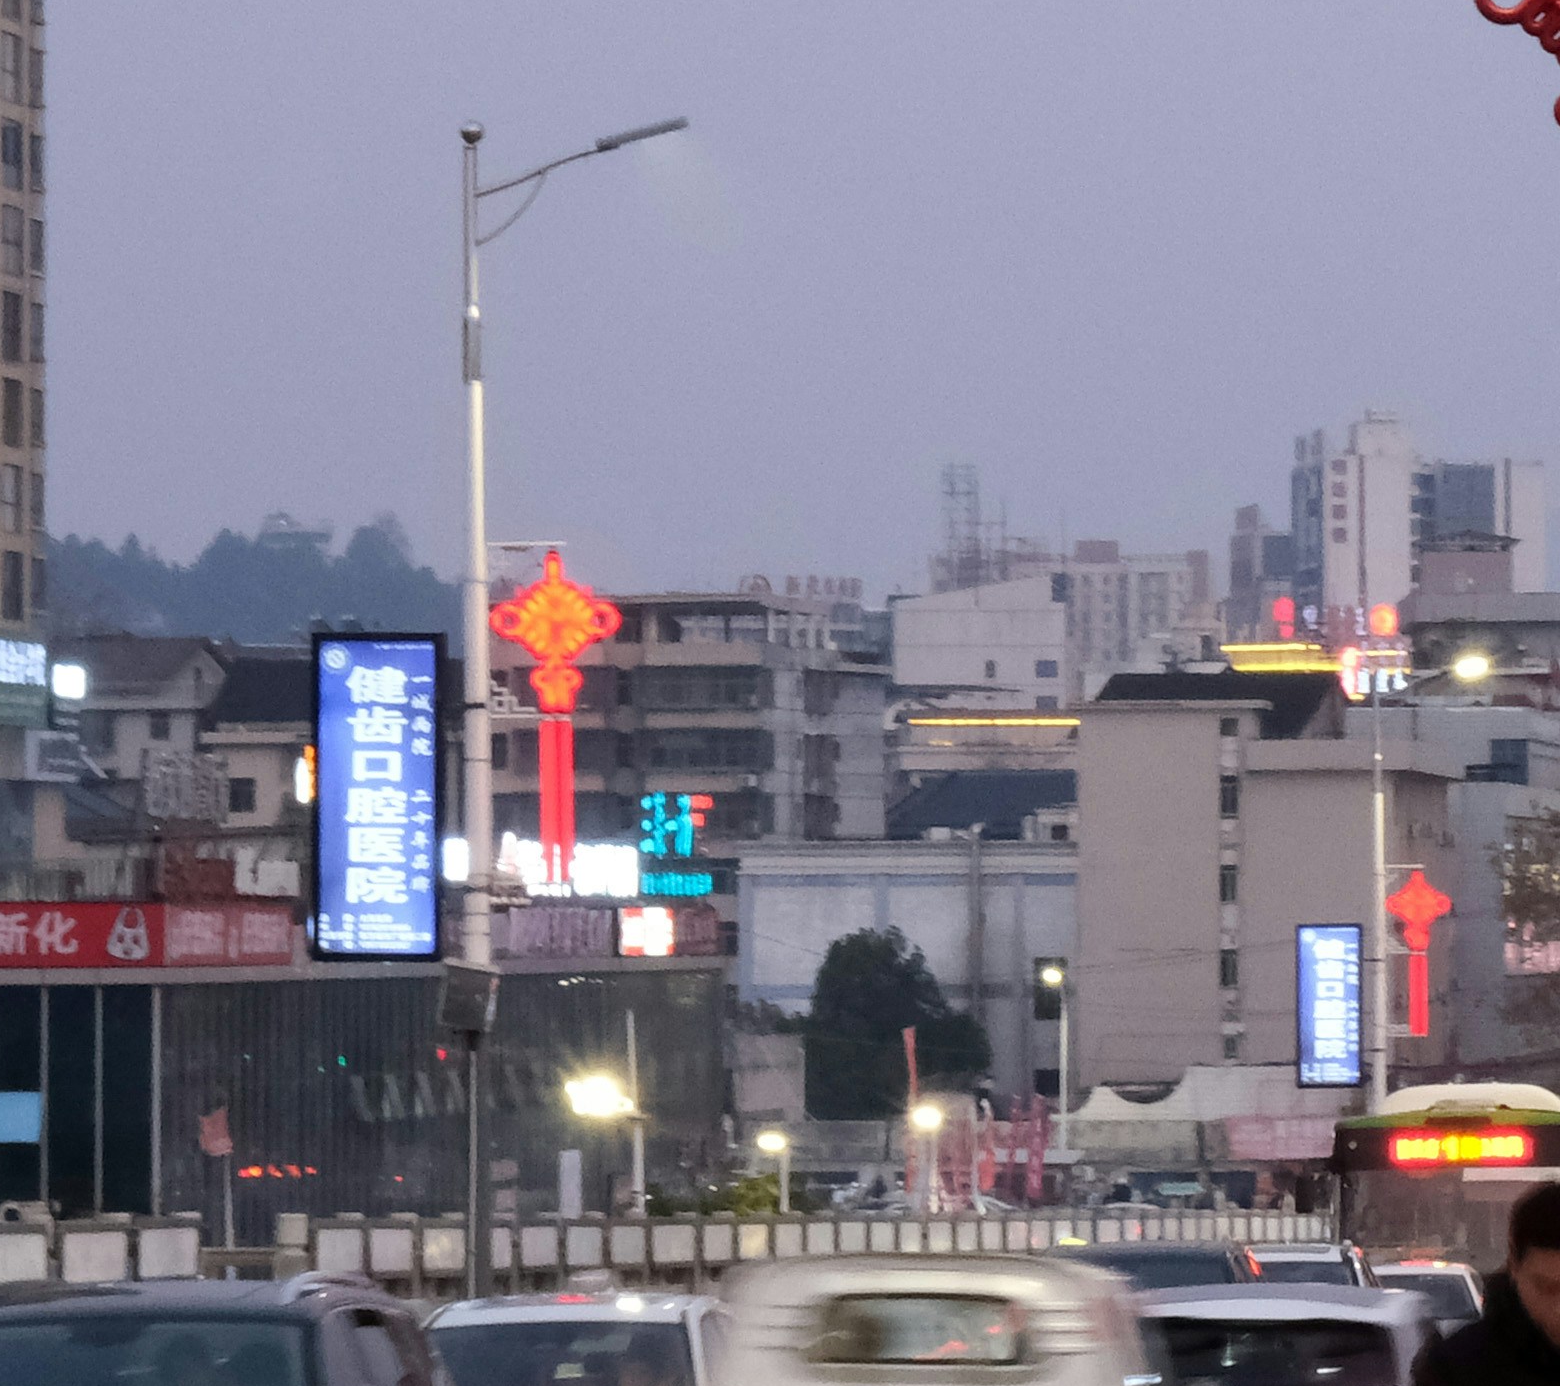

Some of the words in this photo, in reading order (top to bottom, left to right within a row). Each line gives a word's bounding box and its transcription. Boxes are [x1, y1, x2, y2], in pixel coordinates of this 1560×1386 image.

[345, 665, 409, 904] 健齿口腔医院
